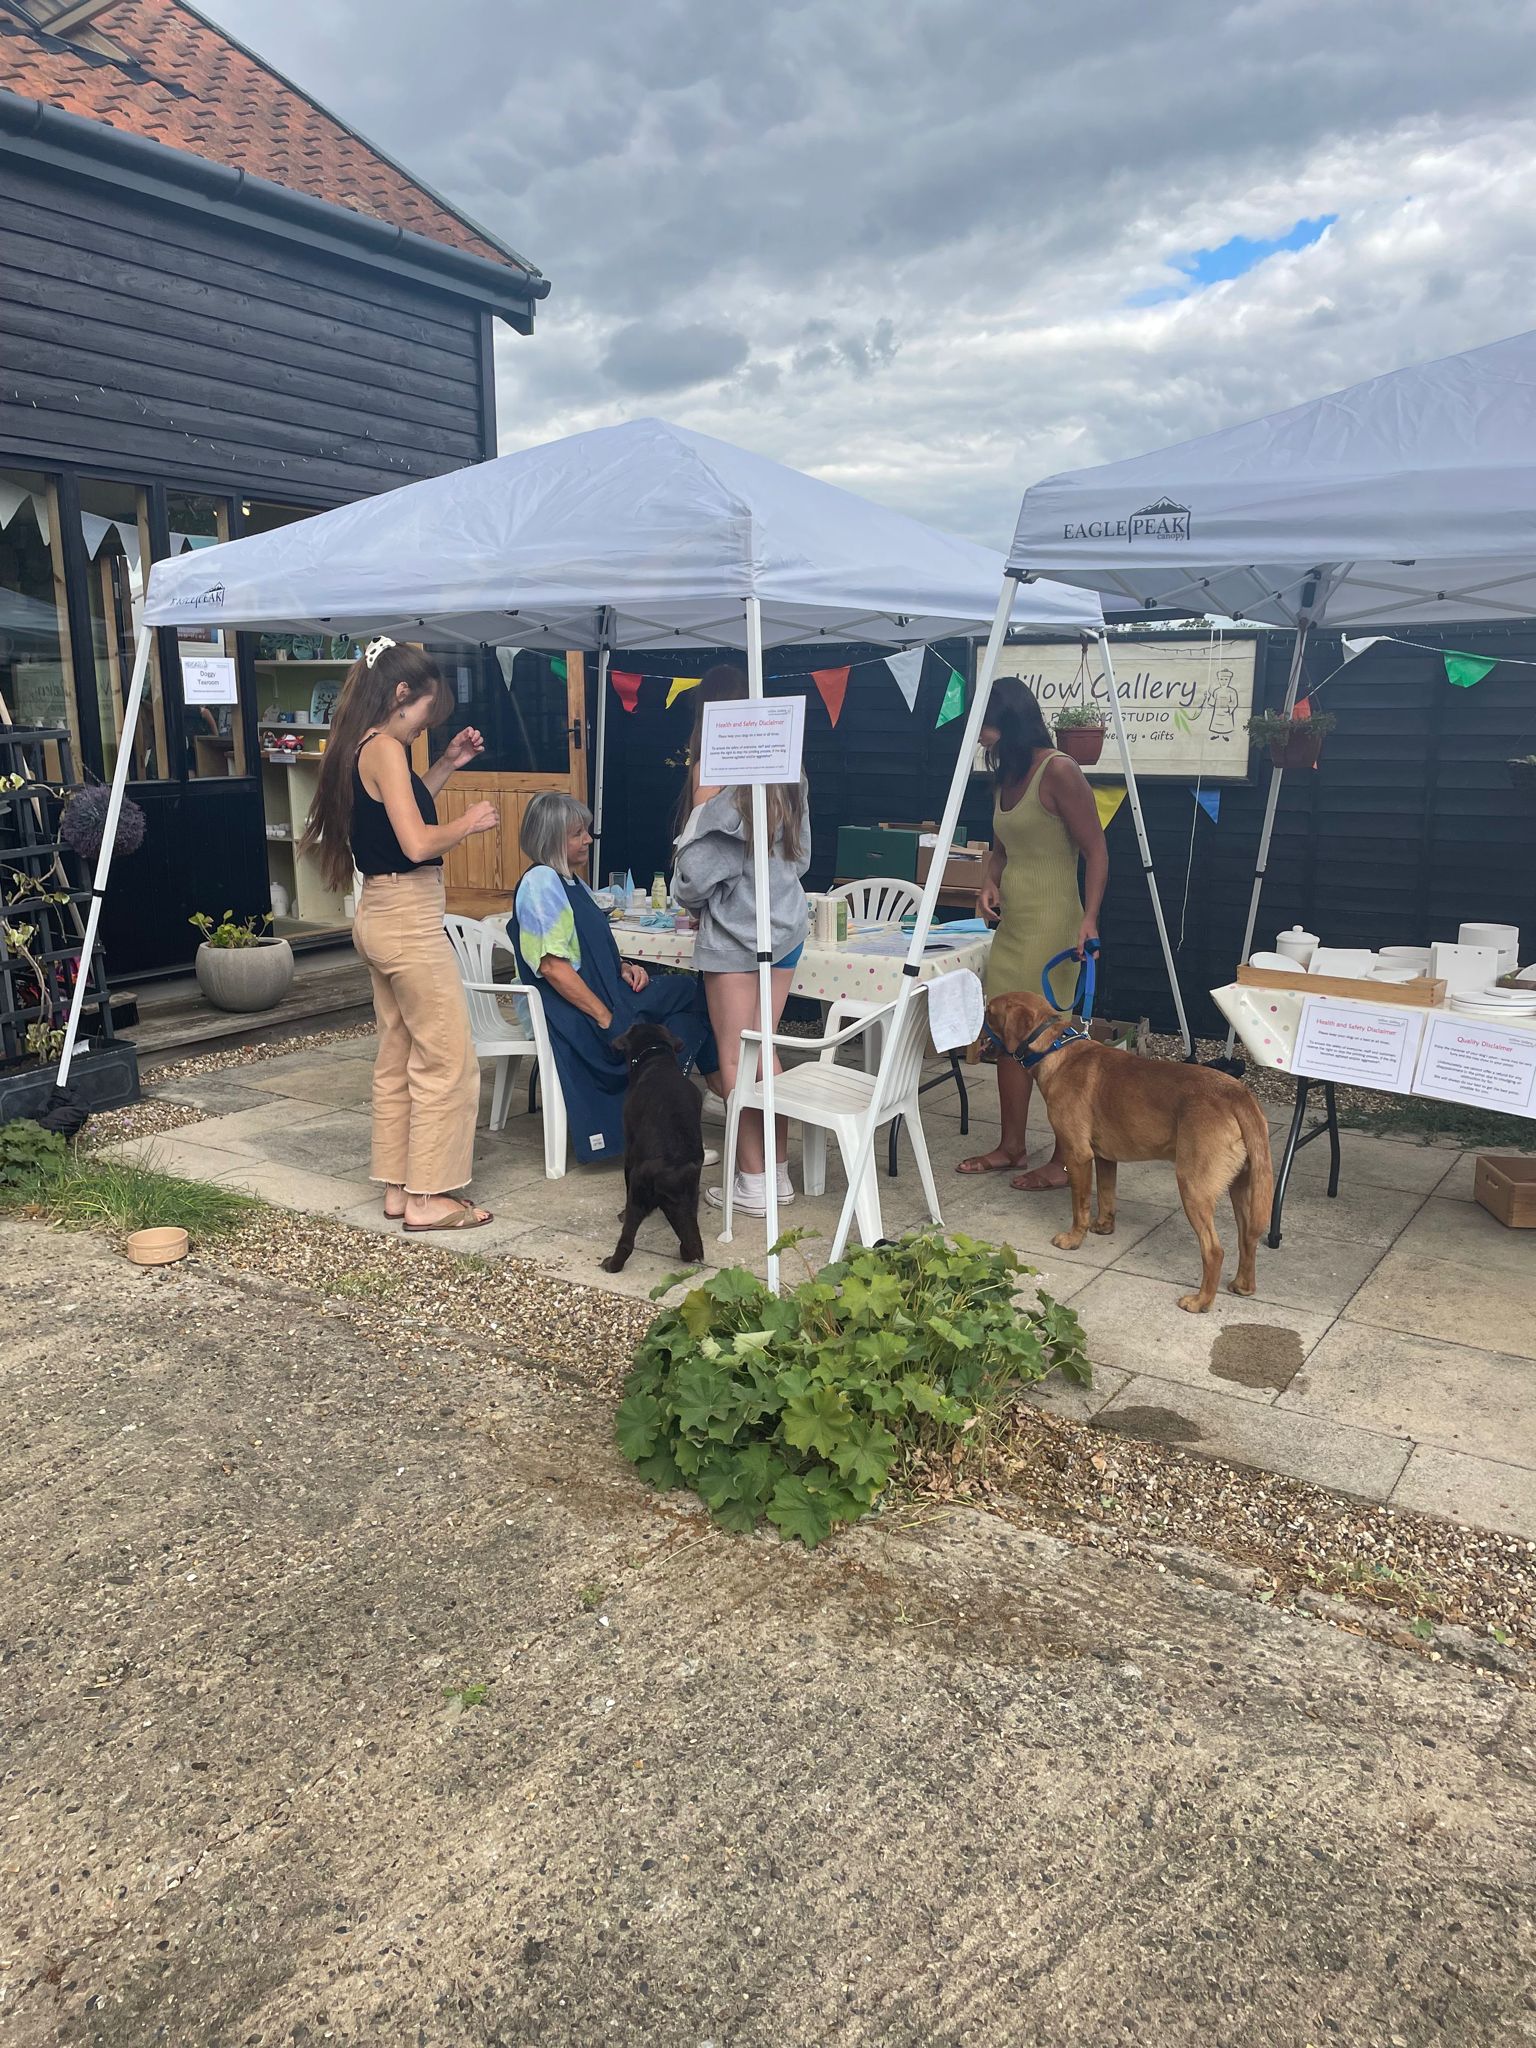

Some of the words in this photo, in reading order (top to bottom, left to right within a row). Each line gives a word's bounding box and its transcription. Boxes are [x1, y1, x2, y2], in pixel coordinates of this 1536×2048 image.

[1063, 520, 1127, 540] EAGLE
[1133, 516, 1186, 535] PEAK
[1156, 530, 1186, 541] canopy
[200, 670, 216, 678] Doggy
[1016, 672, 1082, 700] llow
[1090, 671, 1197, 707] Gallery
[1121, 711, 1170, 723] STUDIO
[733, 720, 742, 728] and
[743, 720, 757, 728] Safety
[1150, 730, 1175, 741] Gifts
[1316, 1018, 1335, 1027] Health
[1336, 1021, 1347, 1029] and
[1348, 1023, 1366, 1032] Safety
[1367, 1026, 1397, 1036] Disclaimer
[1457, 1036, 1479, 1046] Quality
[1481, 1041, 1513, 1052] Disclaimer
